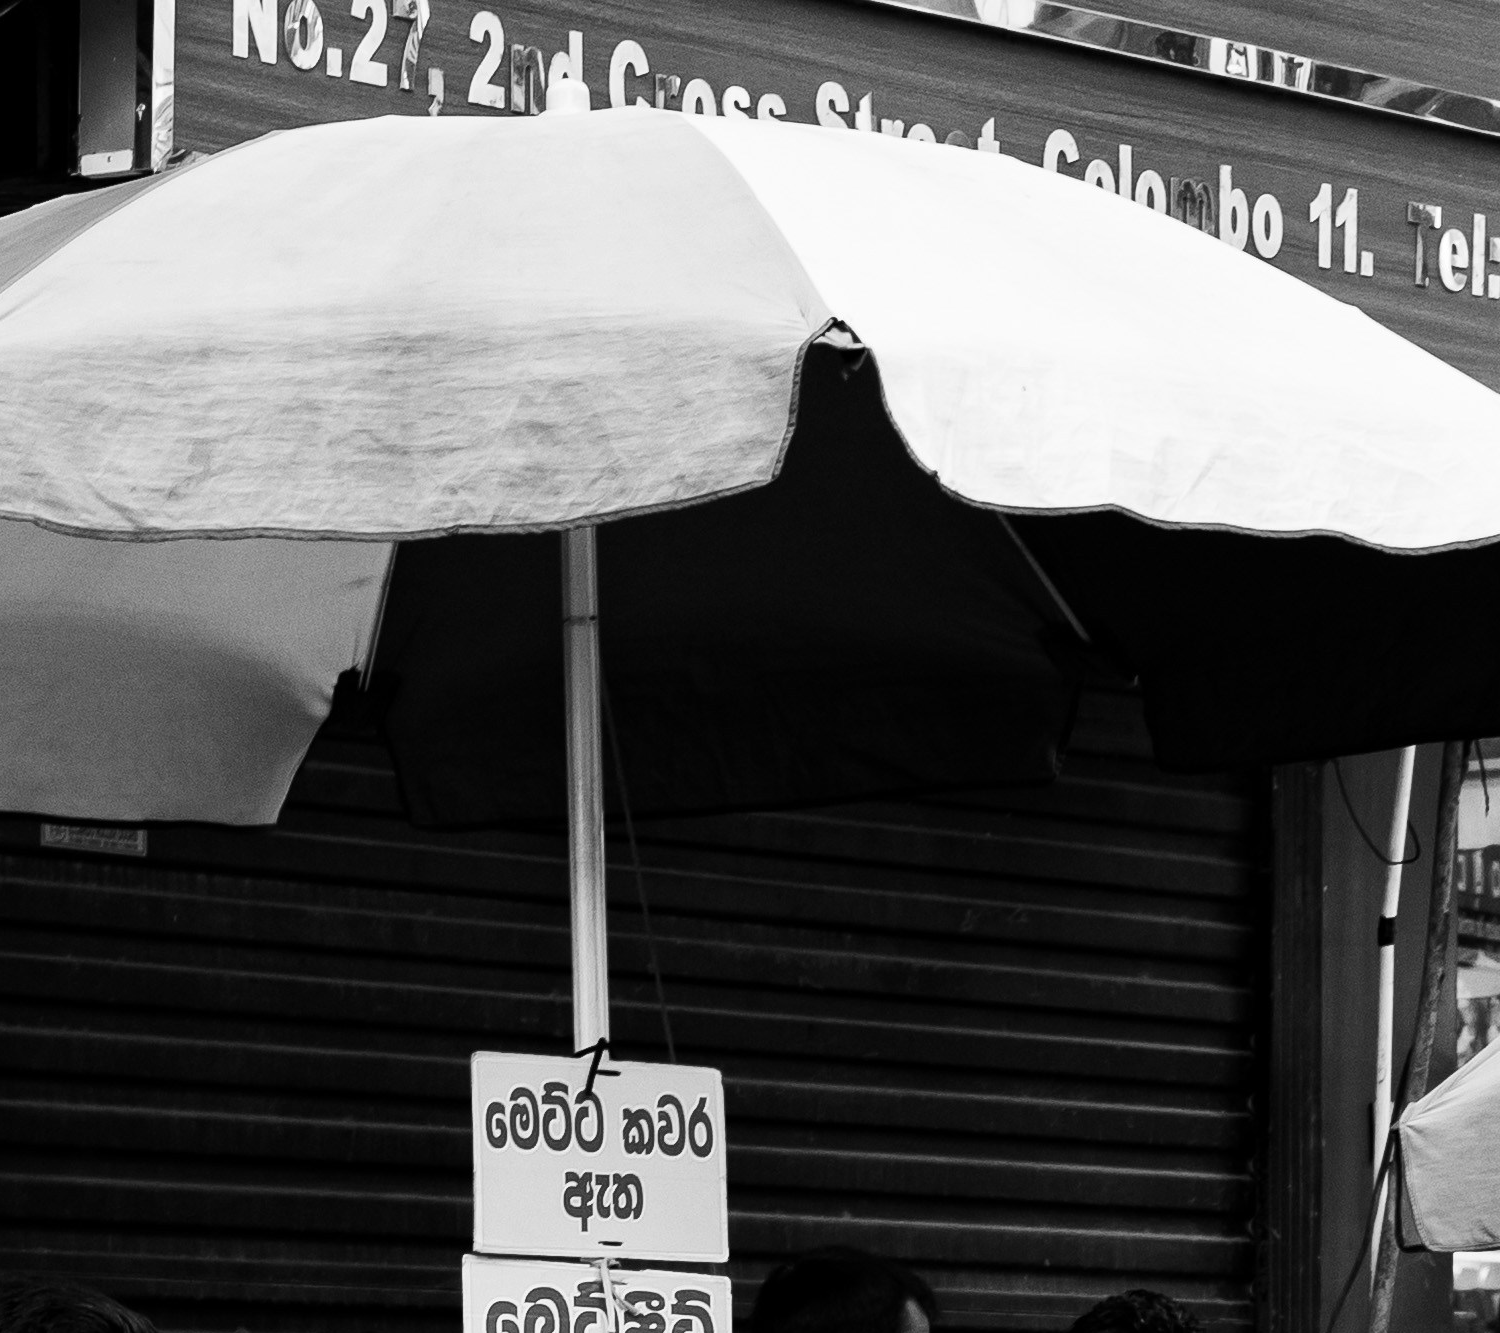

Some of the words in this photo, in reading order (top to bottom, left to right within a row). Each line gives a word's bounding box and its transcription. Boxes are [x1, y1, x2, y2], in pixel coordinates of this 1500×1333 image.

[469, 10, 583, 115] 2nd
[1309, 182, 1375, 278] 11.
[486, 1081, 604, 1153] මෙට්ට
[622, 1094, 714, 1158] කවර
[563, 1171, 644, 1233] ඇත
